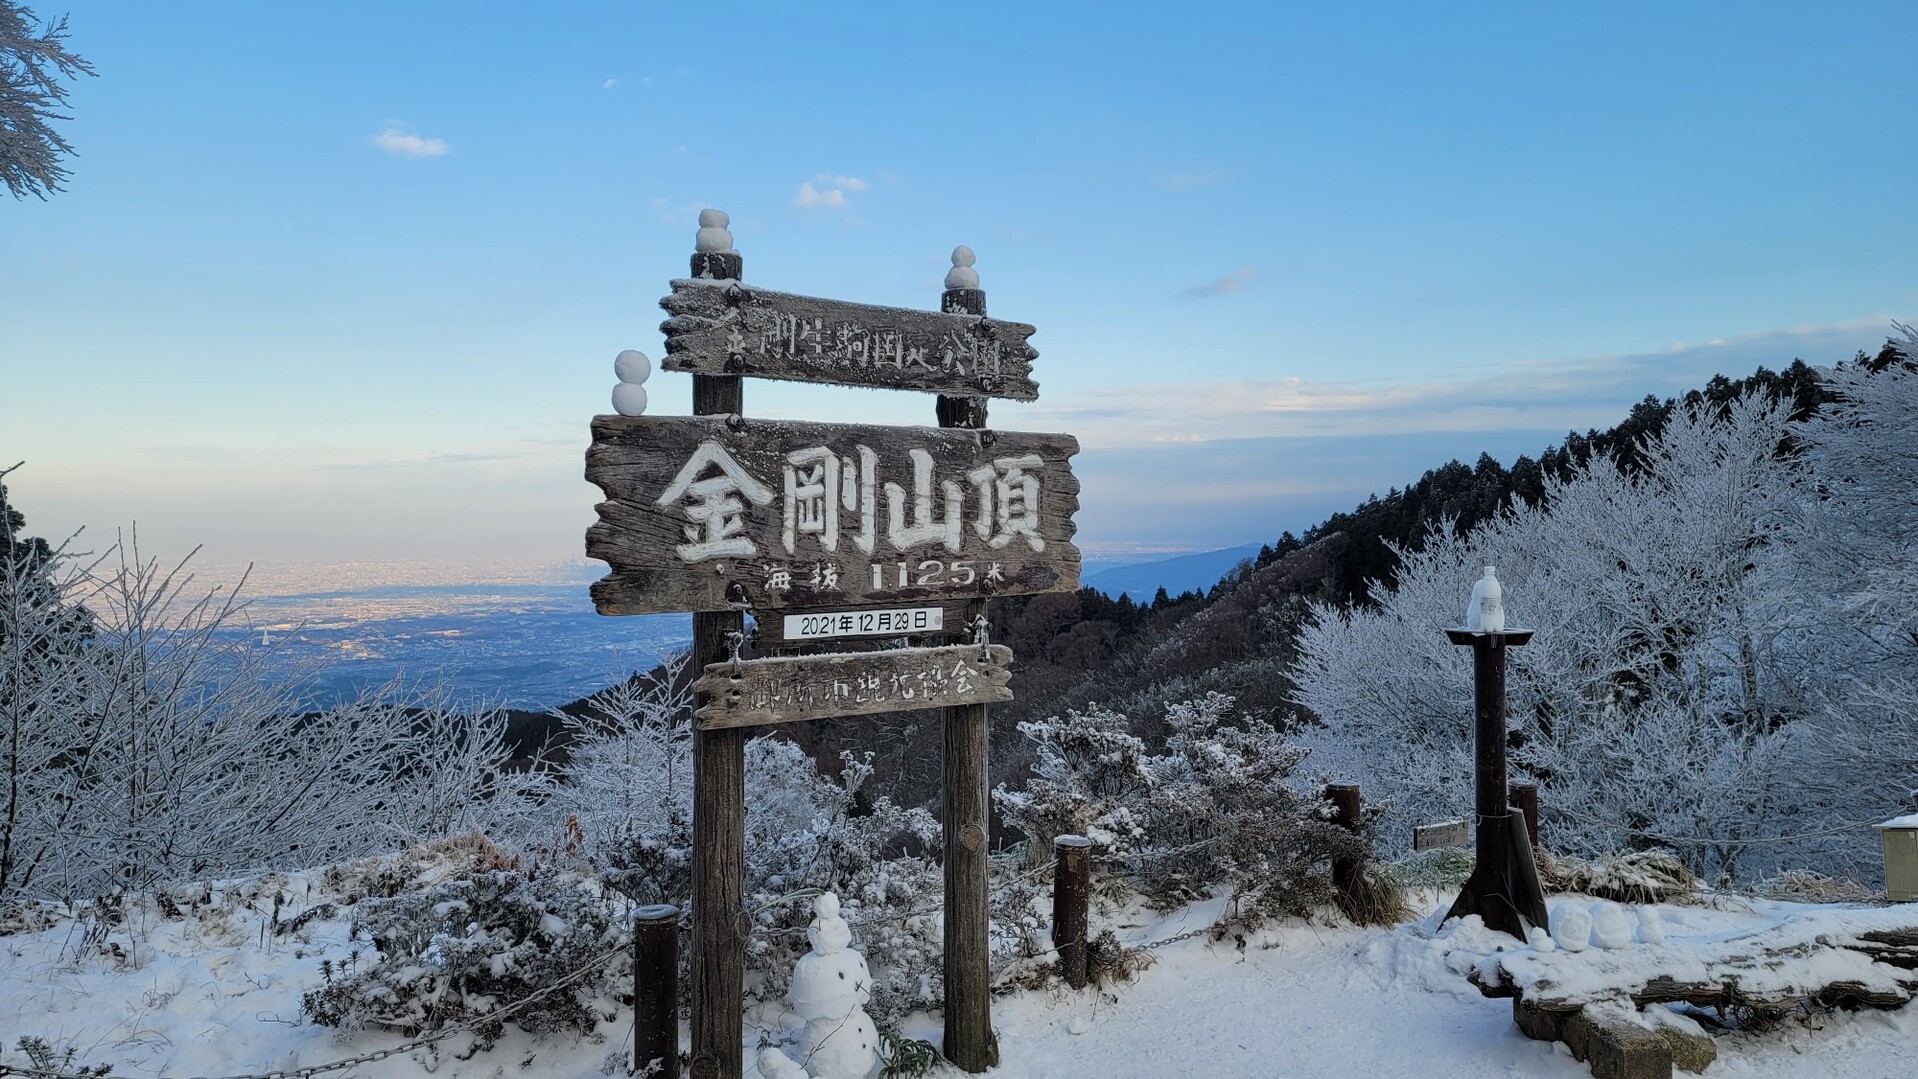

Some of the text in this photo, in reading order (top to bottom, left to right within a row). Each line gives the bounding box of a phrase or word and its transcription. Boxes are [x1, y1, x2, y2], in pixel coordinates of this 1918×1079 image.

[656, 440, 1046, 562] 金剛山頂
[801, 611, 927, 636] 2021年12月29日
